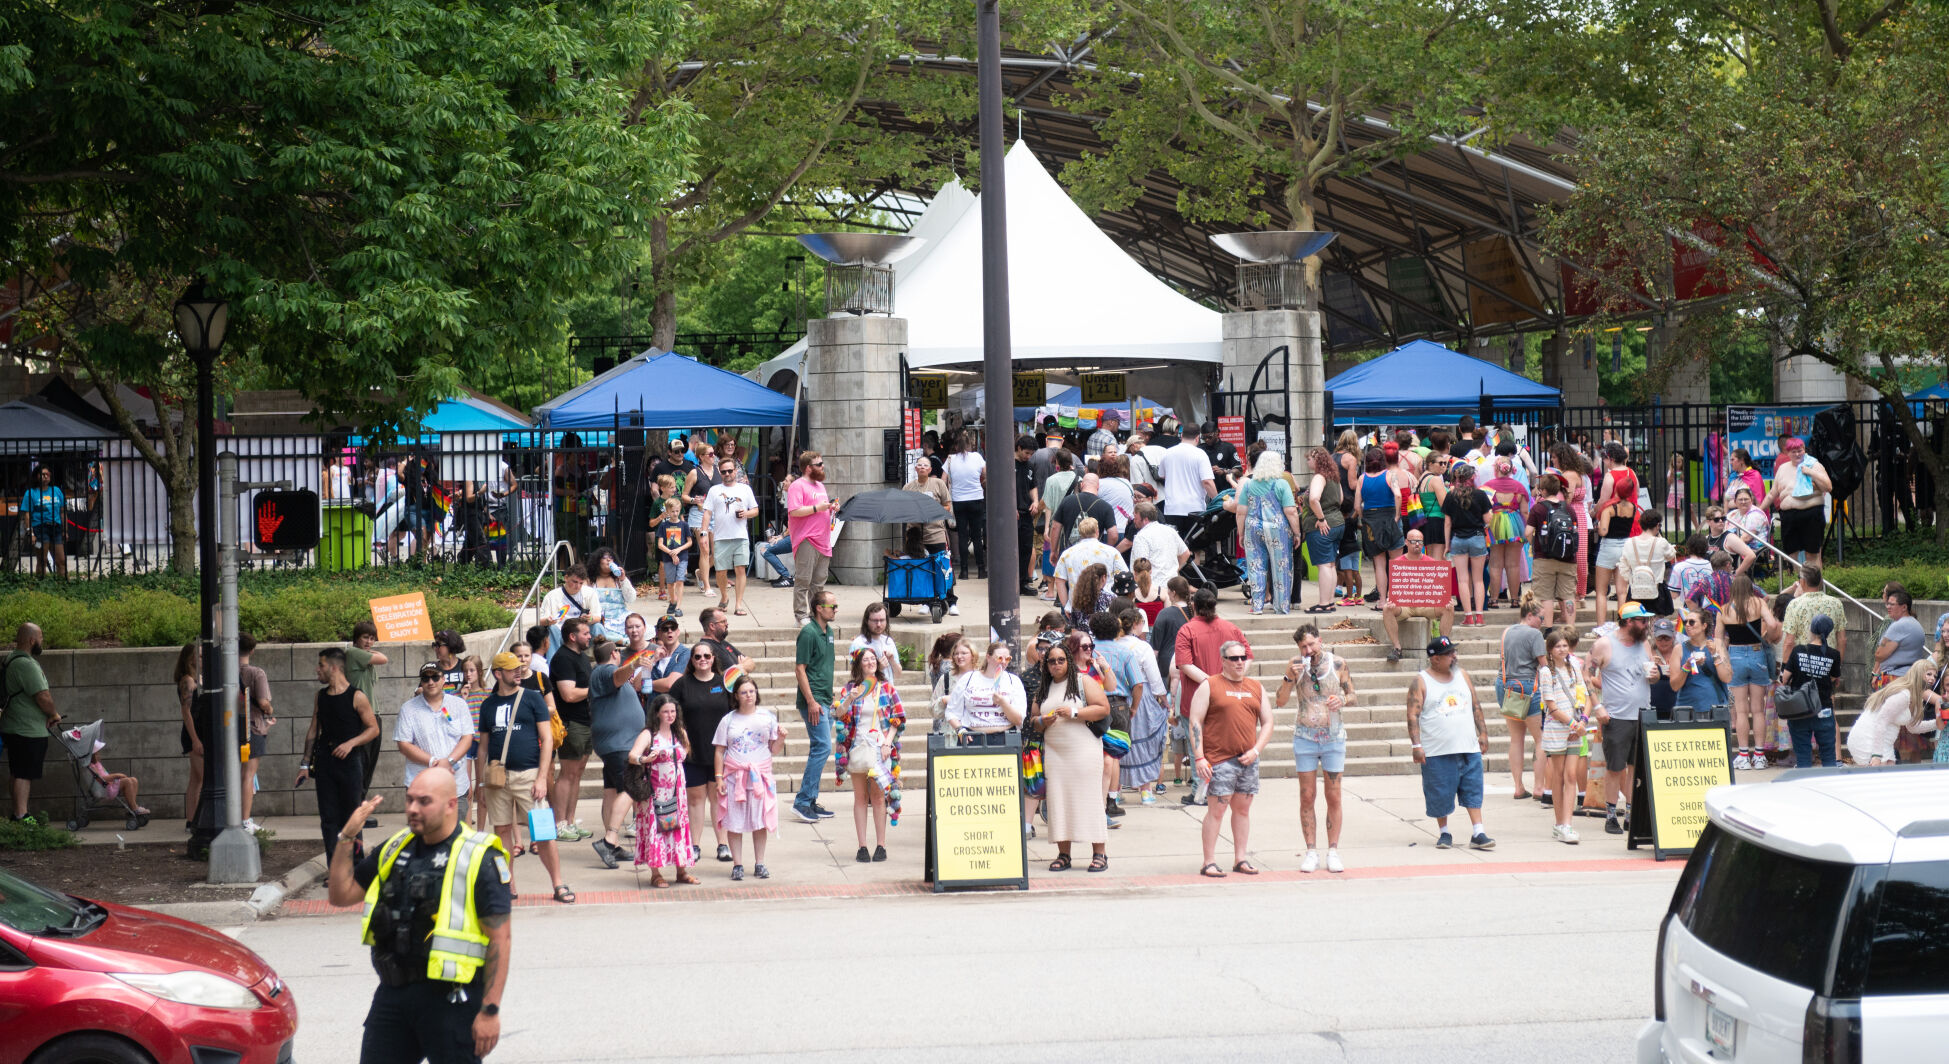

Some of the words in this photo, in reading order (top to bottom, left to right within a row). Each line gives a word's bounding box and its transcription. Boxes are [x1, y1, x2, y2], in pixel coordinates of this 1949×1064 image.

[1085, 374, 1121, 384] Under
[1016, 388, 1030, 398] 21
[1096, 384, 1110, 394] 21
[1515, 435, 1526, 445] nd
[1742, 440, 1780, 457] TICK
[390, 629, 410, 638] ENJOY
[1654, 742, 1672, 752] USE
[1676, 740, 1722, 752] EXTREME
[1654, 759, 1695, 770] CAUTION
[1697, 758, 1725, 768] WHEN
[940, 769, 960, 780] USE
[964, 768, 1013, 778] EXTREME
[1665, 776, 1718, 787] CROSSING
[939, 786, 983, 798] CAUTION
[986, 786, 1015, 796] WHEN
[950, 804, 1006, 815] CROSSING
[1680, 802, 1705, 811] SHOR
[1671, 816, 1710, 825] CROSSWA
[964, 831, 994, 840] SHORT
[1687, 830, 1704, 838] TIM
[953, 845, 1006, 855] CROSSWALK
[969, 860, 992, 869] TIME
